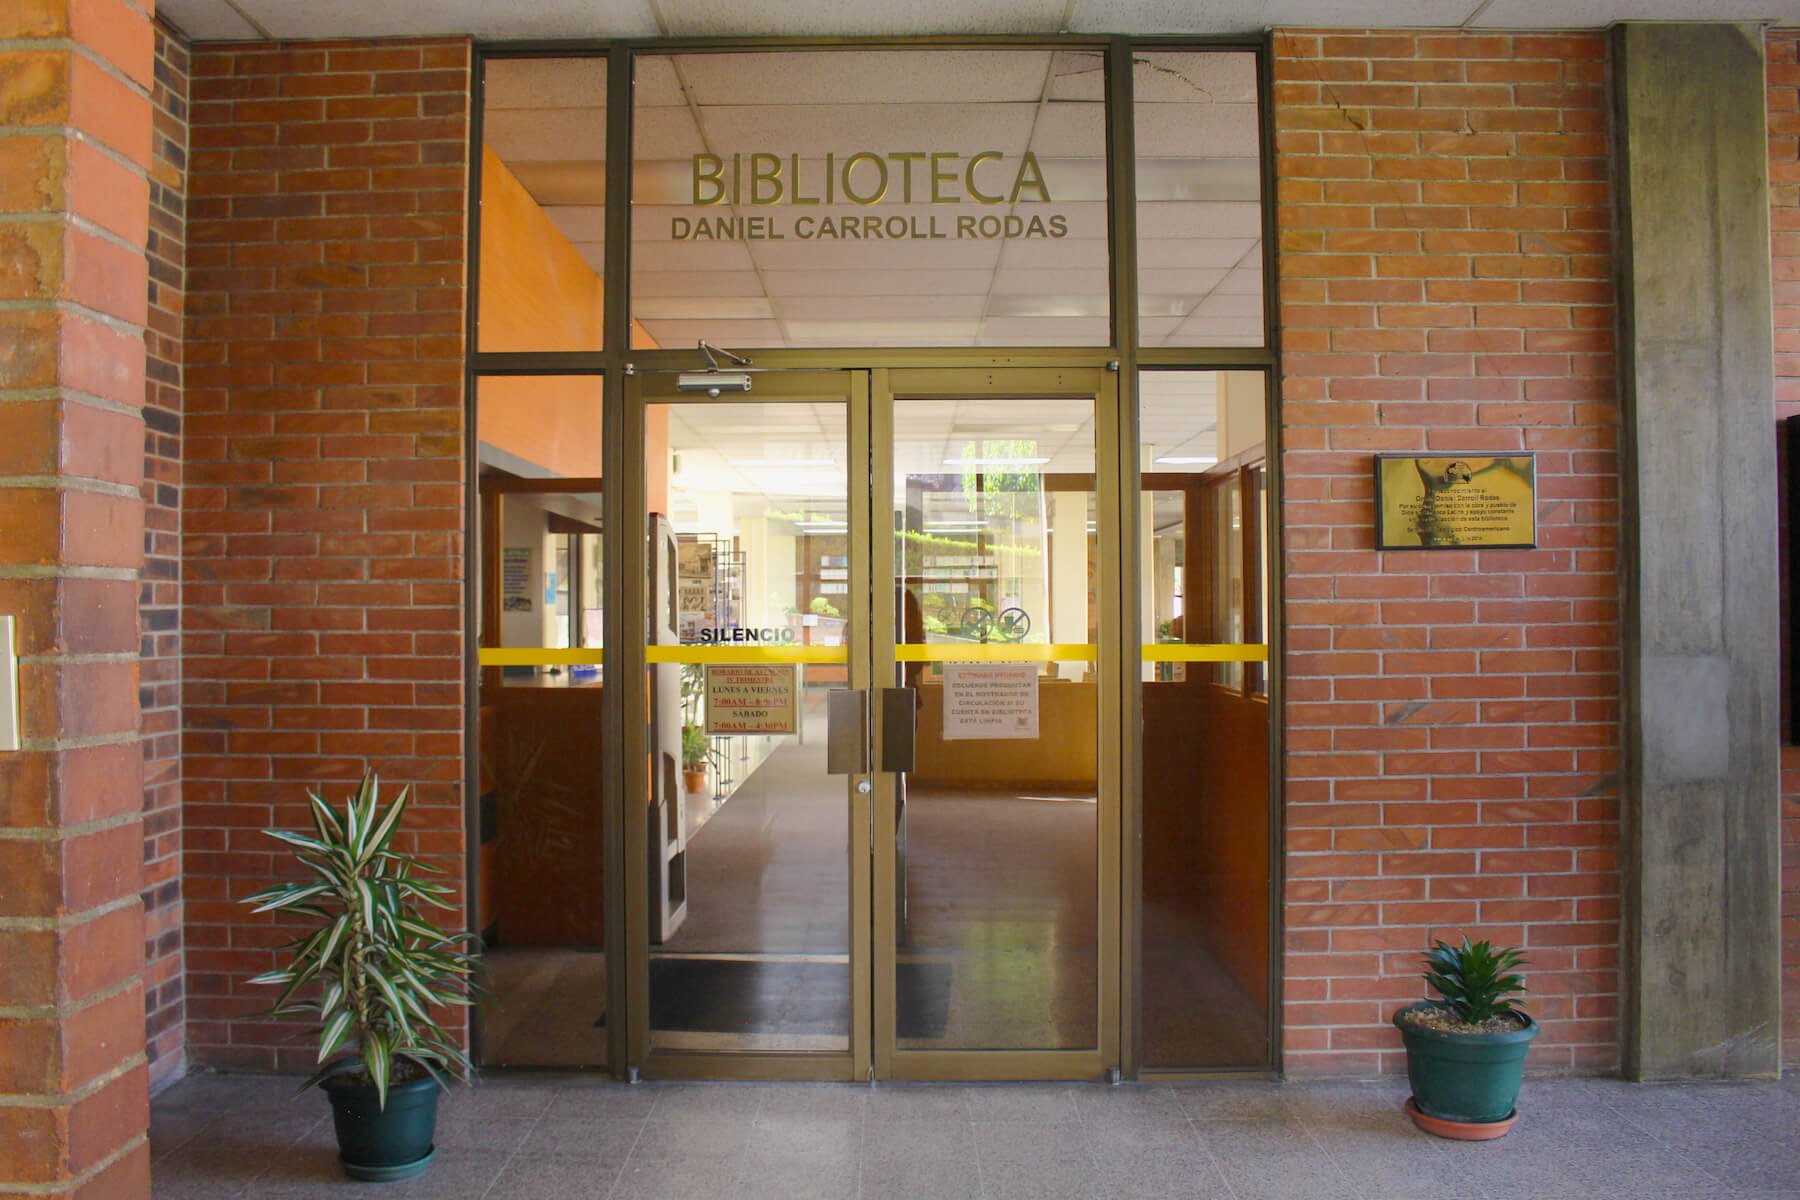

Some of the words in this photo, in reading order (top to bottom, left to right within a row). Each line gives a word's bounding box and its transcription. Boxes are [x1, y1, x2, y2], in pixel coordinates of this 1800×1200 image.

[692, 151, 1051, 205] BIBLIOTECA
[671, 216, 784, 239] DANIEL
[795, 215, 946, 239] CARROLL
[957, 215, 1068, 238] RODAS
[700, 627, 795, 642] SILENCIO
